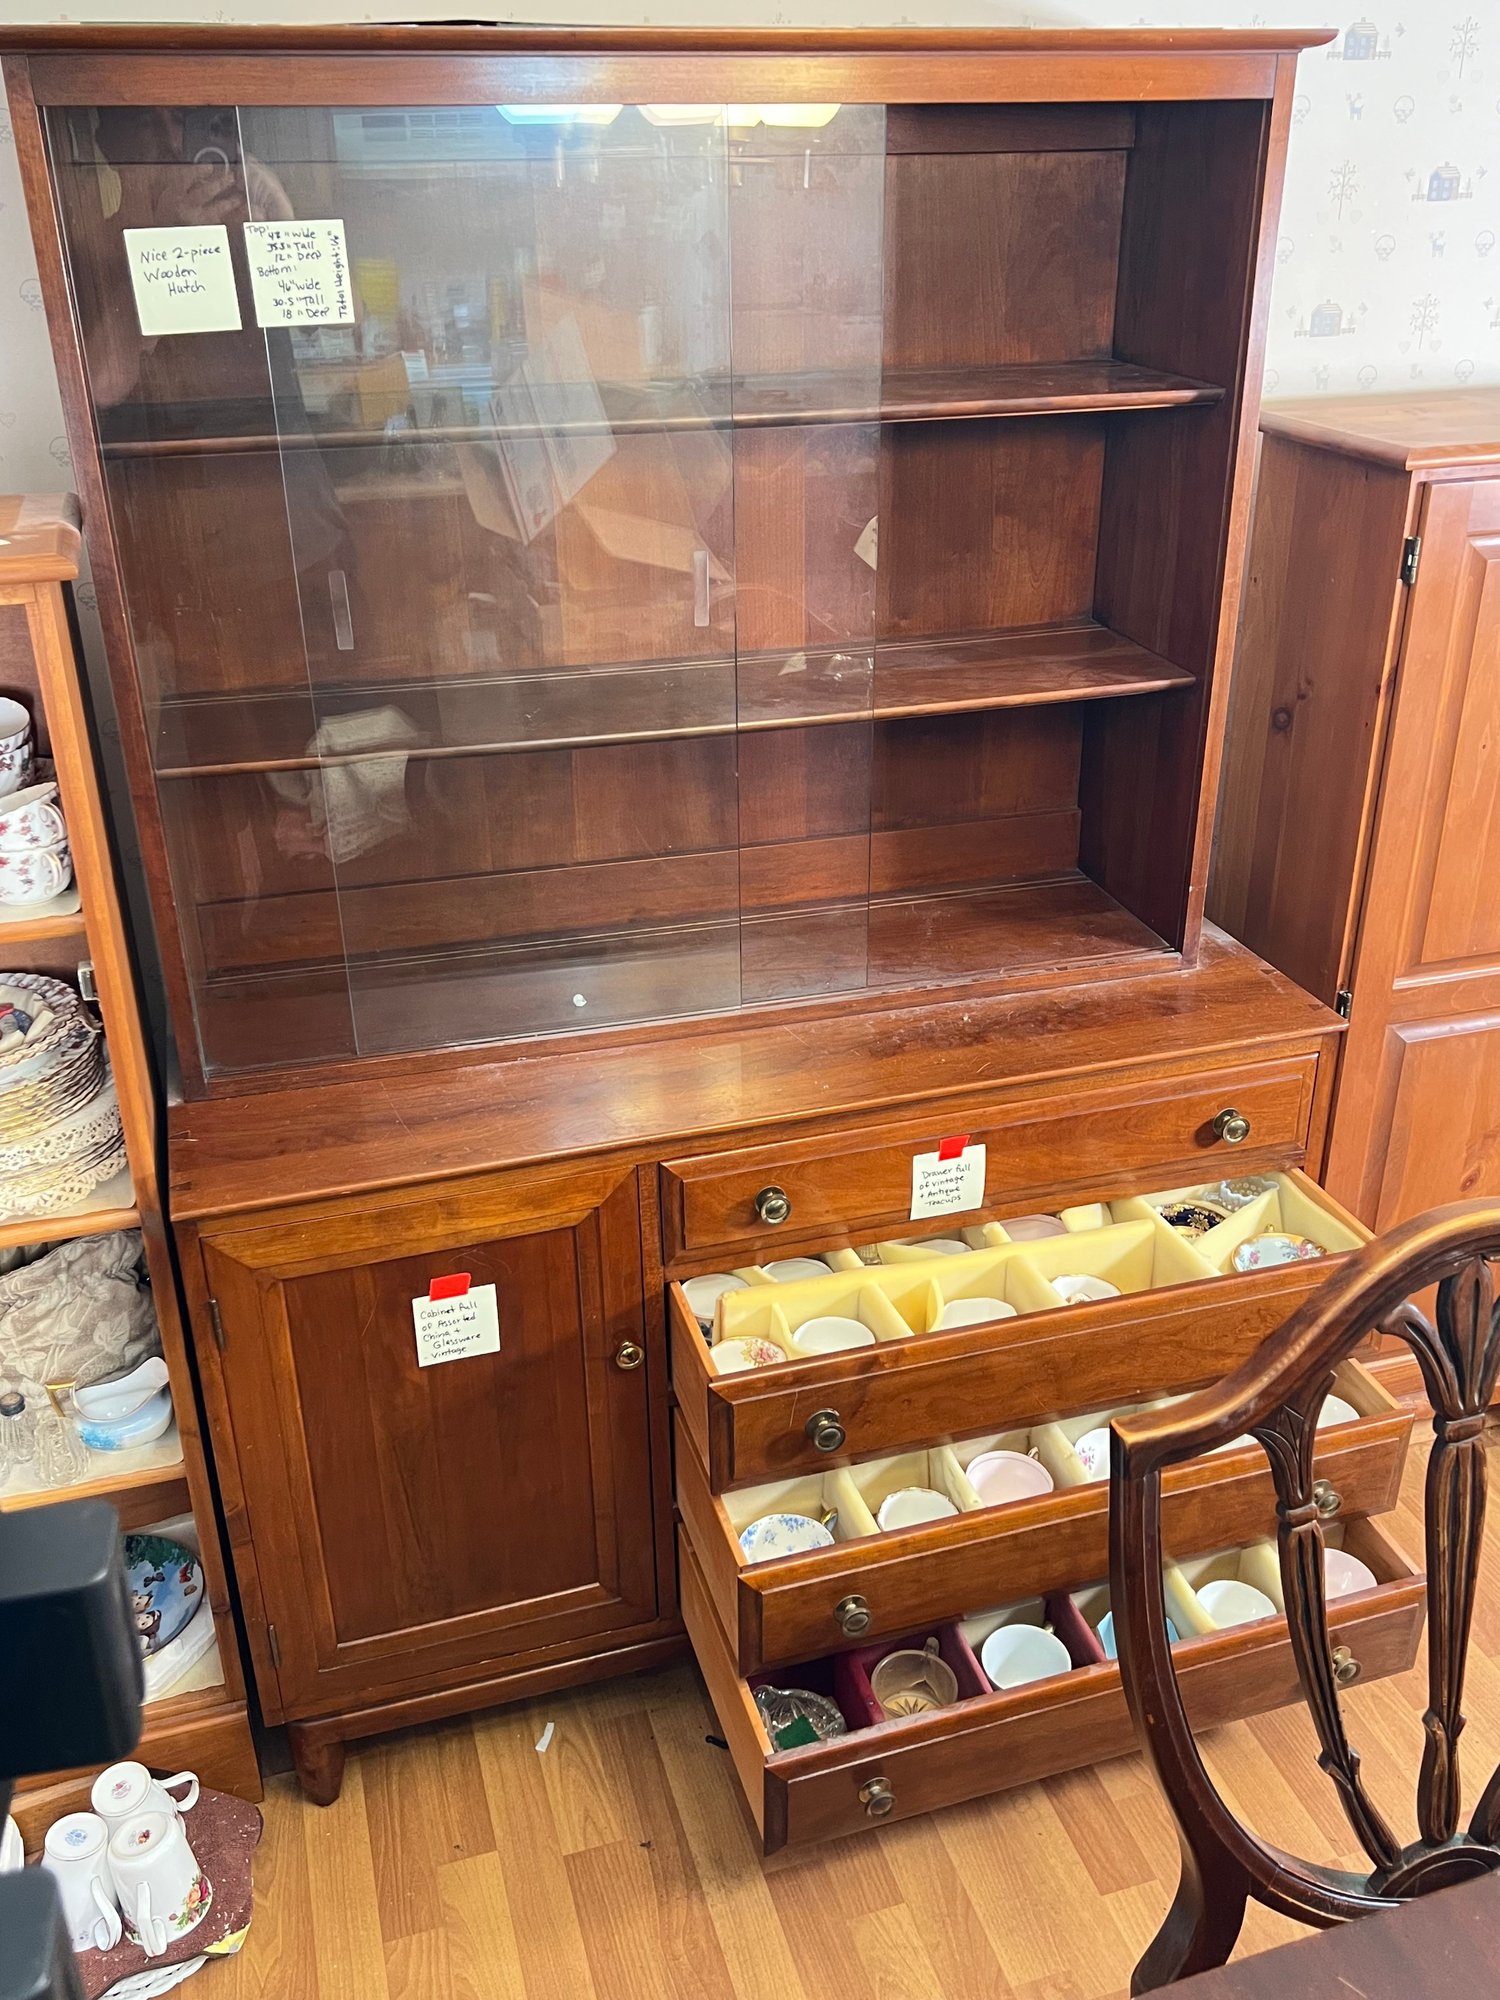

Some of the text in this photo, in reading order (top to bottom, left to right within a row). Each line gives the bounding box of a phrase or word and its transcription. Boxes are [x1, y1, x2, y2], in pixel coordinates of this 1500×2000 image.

[293, 241, 315, 251] Tall
[141, 244, 221, 263] Nice 2-piece
[144, 264, 197, 283] Wooden
[167, 279, 206, 296] Hutch
[922, 1168, 952, 1179] Drawer
[919, 1182, 930, 1190] of
[420, 1305, 455, 1319] Cabinet
[422, 1322, 432, 1332] of
[423, 1331, 451, 1342] China
[433, 1333, 481, 1349] Glassware
